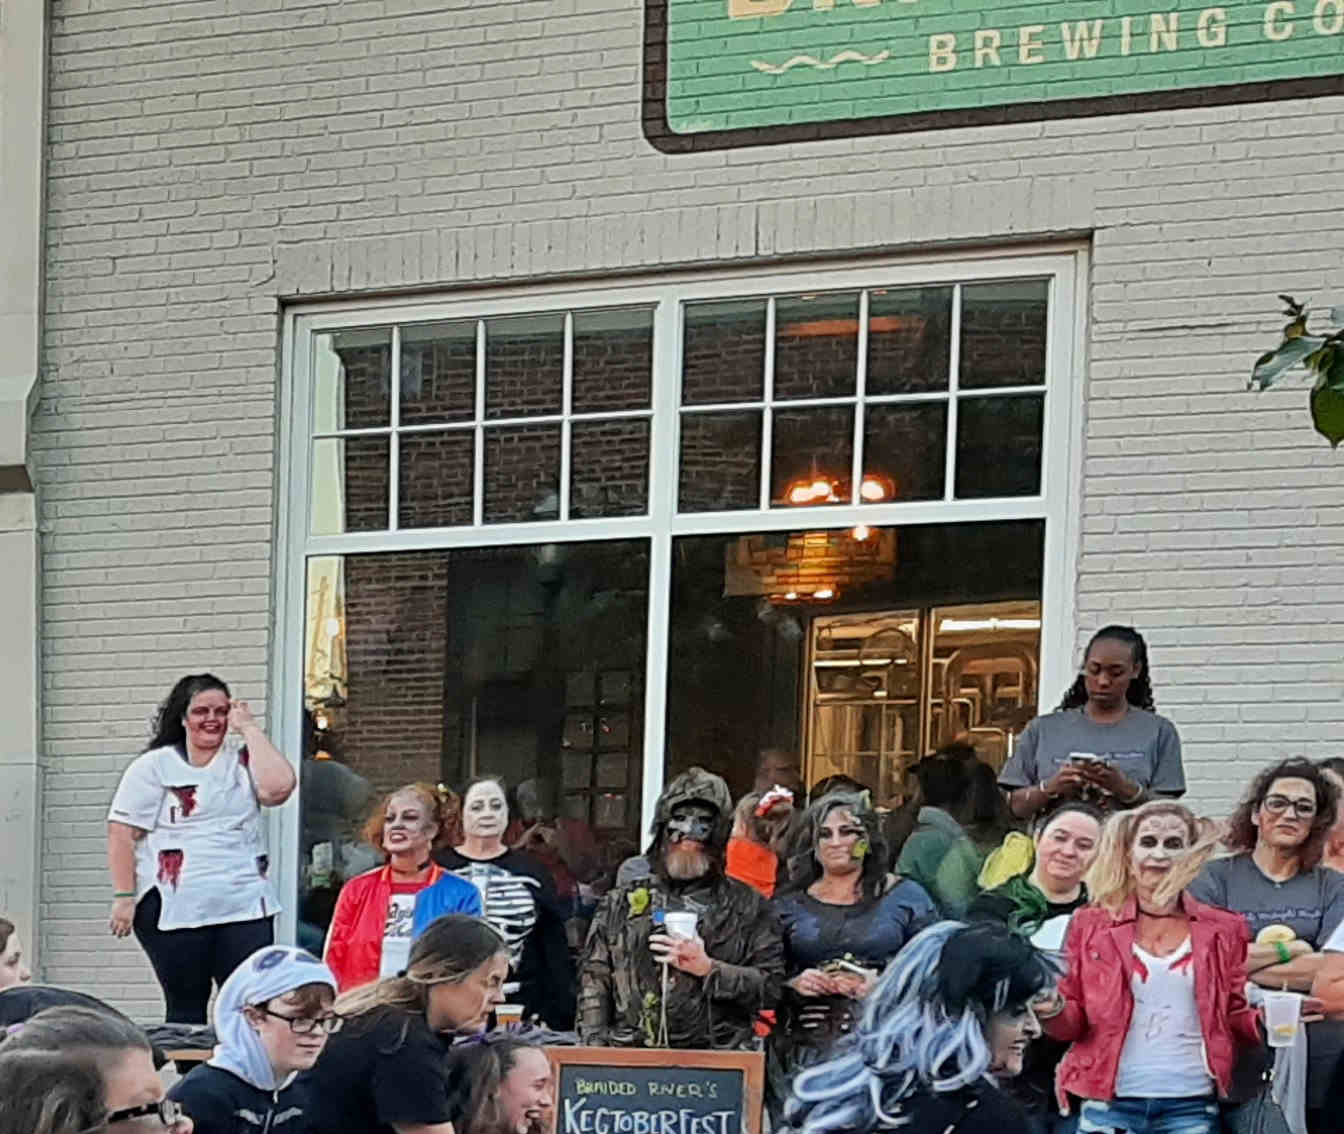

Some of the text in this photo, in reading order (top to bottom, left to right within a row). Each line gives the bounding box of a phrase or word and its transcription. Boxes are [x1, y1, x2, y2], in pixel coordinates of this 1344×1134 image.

[928, 6, 1227, 72] BREWING
[575, 1079, 718, 1099] BRAIDED RIVER'S
